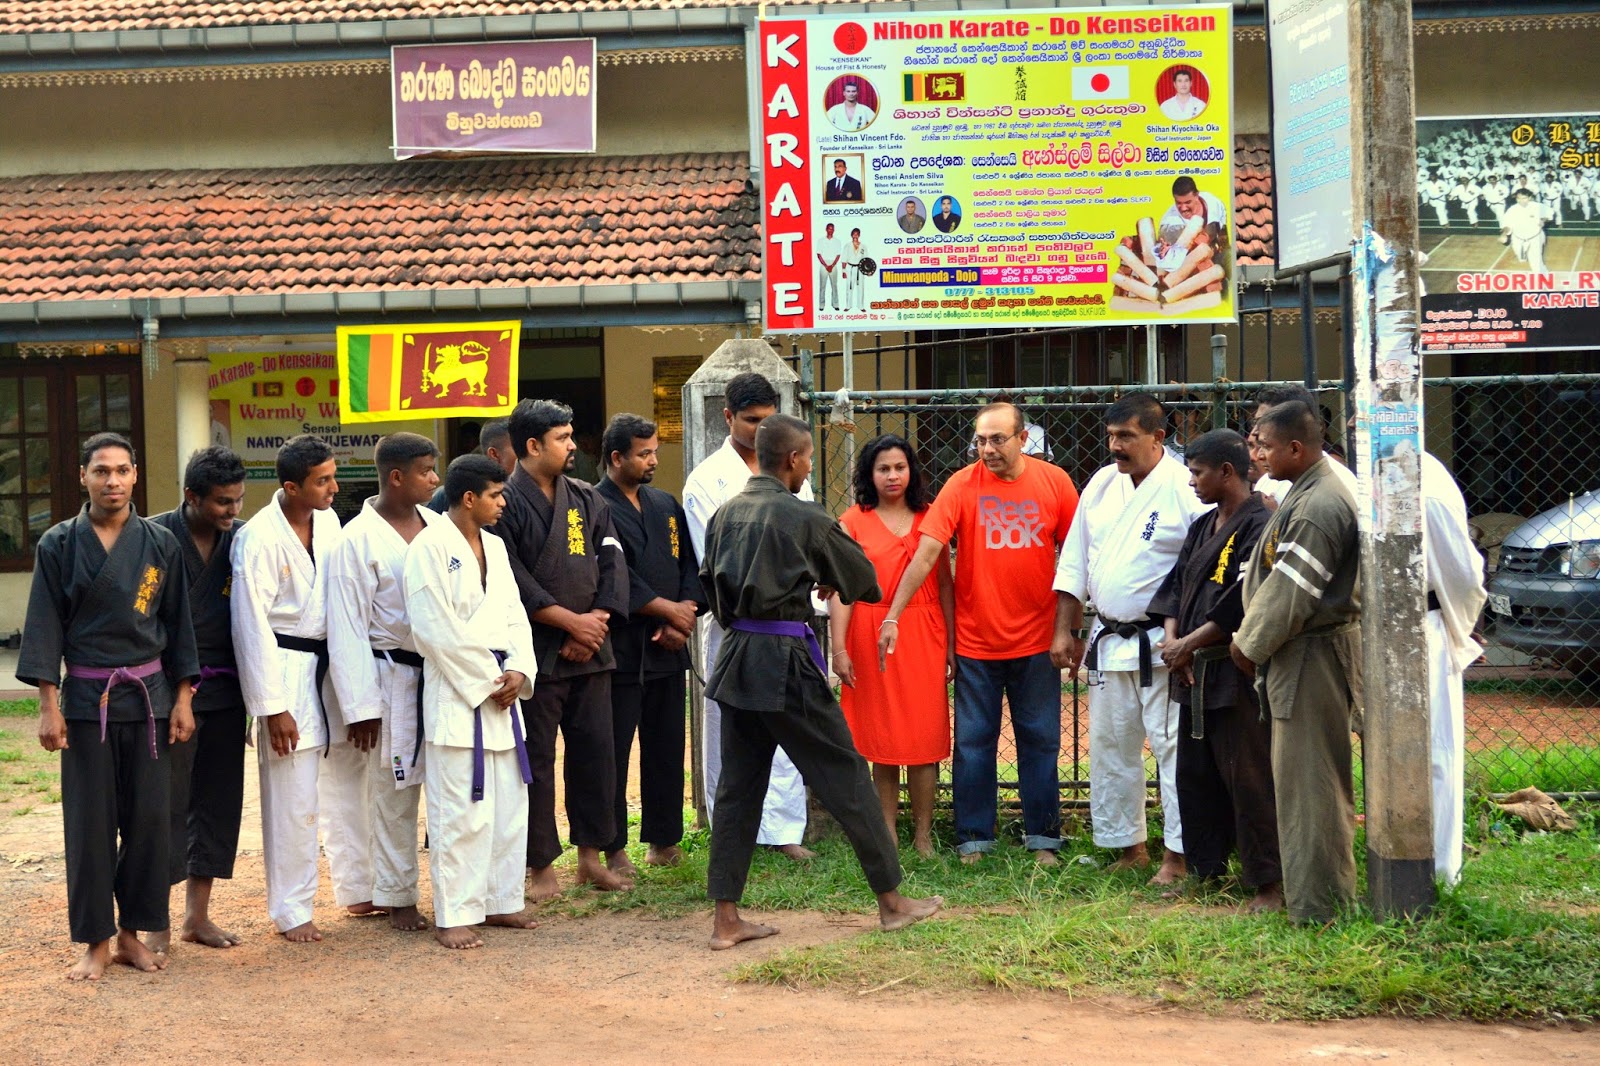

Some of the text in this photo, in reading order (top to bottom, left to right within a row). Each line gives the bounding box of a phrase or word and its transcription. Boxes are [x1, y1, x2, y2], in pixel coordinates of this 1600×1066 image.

[873, 14, 1216, 40] Nihon Karate Do Kenseikan
[1085, 52, 1111, 63] ලංකා
[400, 55, 591, 109] තරුණ බෞද්ධ සංගමය
[445, 111, 543, 135] මිනුවන්ගොඩ
[1146, 123, 1220, 134] Shihan Kiyochika Oka
[833, 133, 906, 142] Shihan Vincent Fdo.
[766, 33, 805, 316] KARATE
[882, 269, 978, 284] Minuwangoda Dojo
[1457, 272, 1554, 292] SHORIN
[944, 286, 1035, 297] 0777 313105
[1522, 293, 1599, 309] KARATE
[220, 361, 255, 385] Karate
[262, 356, 276, 373] Do
[278, 352, 335, 370] Kenseikan
[239, 402, 307, 422] Warmly
[302, 423, 341, 434] Sensei
